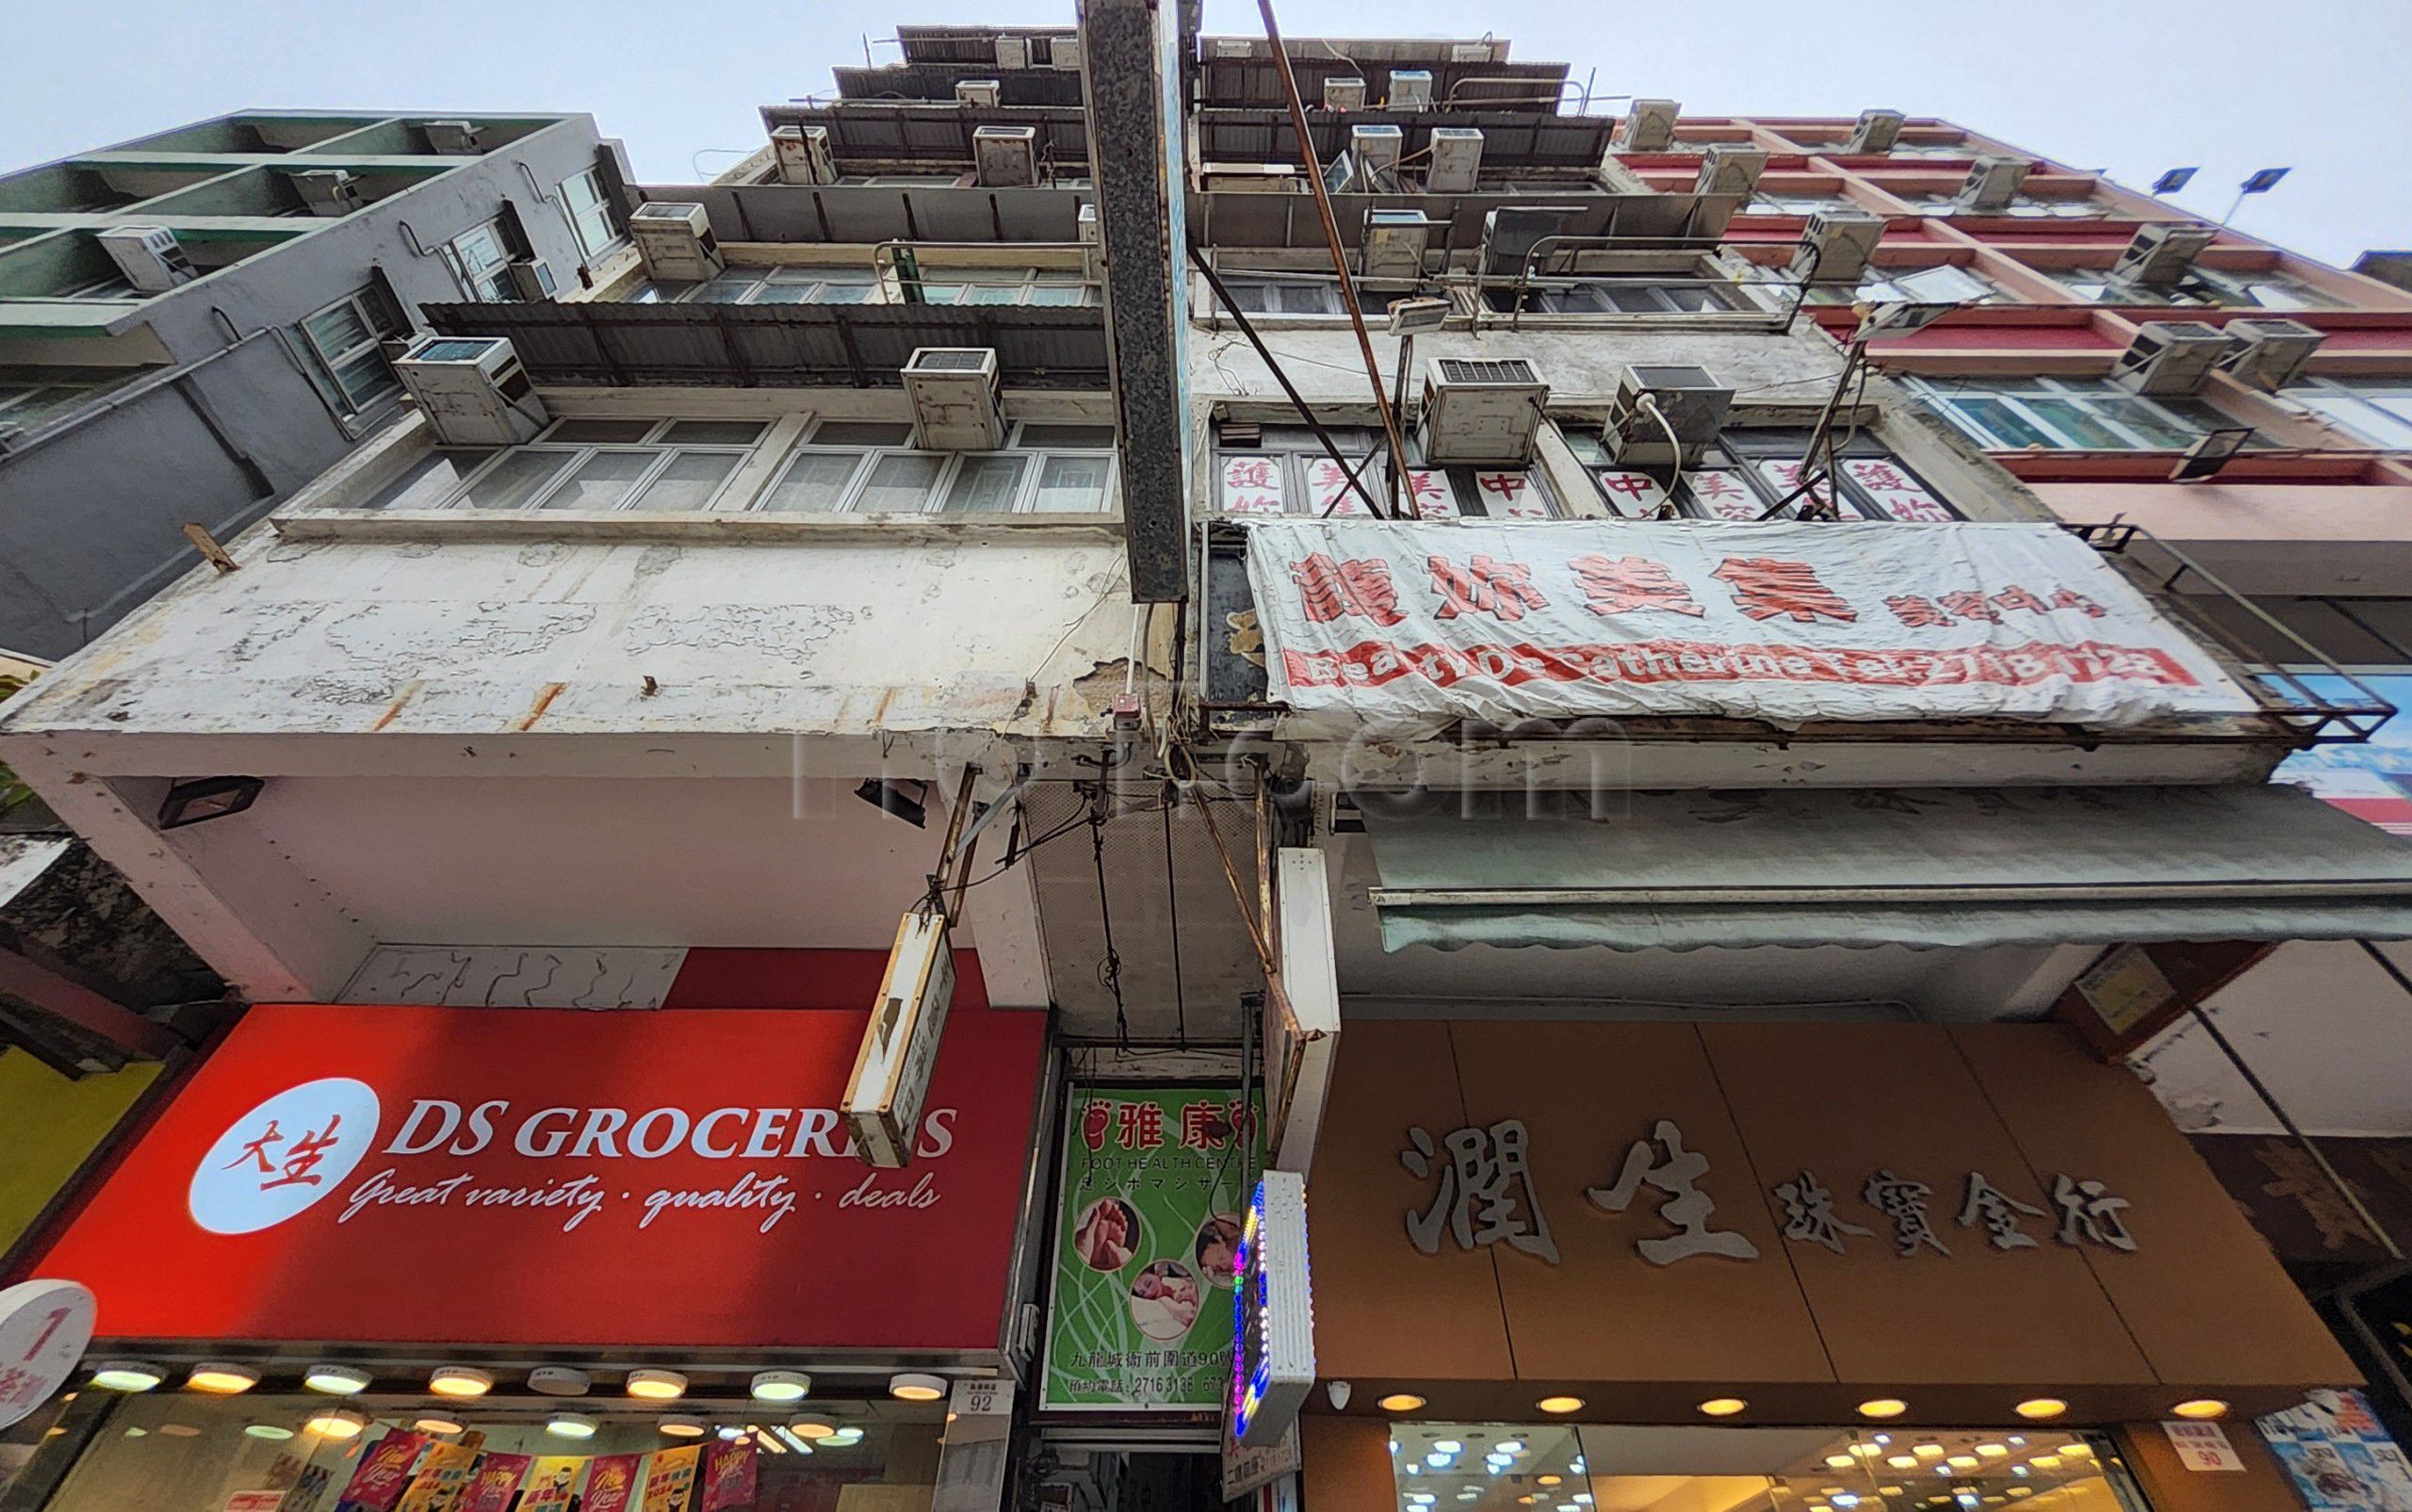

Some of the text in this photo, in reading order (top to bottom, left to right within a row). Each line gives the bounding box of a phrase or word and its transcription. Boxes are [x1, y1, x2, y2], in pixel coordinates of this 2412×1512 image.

[220, 1114, 344, 1192] 大生
[382, 1099, 957, 1160] DS GROCERS
[1081, 1158, 1122, 1170] FOOT
[338, 1168, 940, 1233] Great variety quality deals
[970, 1395, 992, 1411] 92
